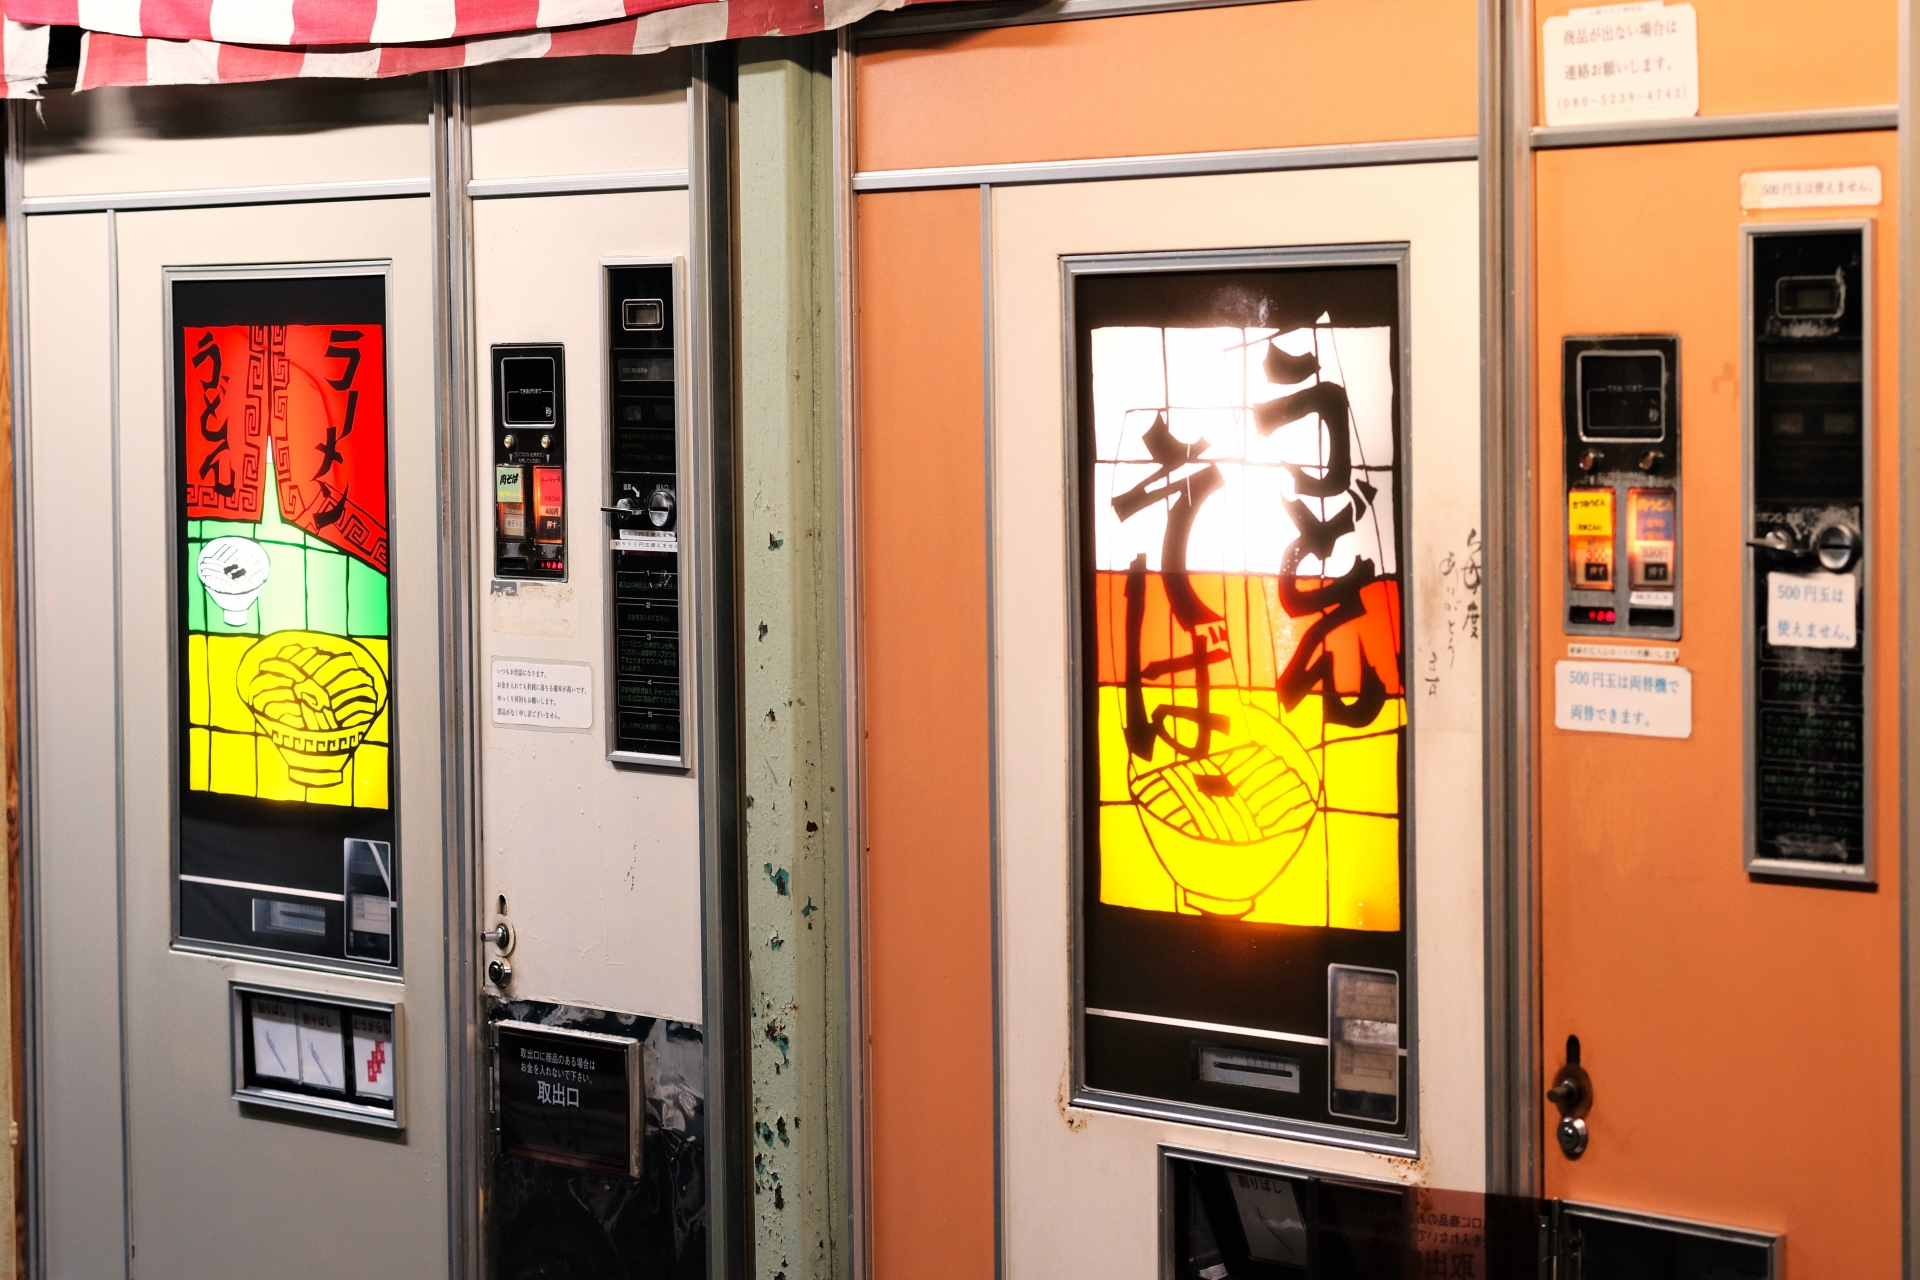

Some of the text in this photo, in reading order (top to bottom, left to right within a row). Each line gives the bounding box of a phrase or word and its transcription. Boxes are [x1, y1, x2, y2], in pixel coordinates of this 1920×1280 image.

[1563, 20, 1678, 46] 商品が出ない場合は
[1564, 57, 1673, 80] 連絡お願いします。
[191, 330, 236, 498] うどん
[312, 329, 366, 531] ラーメン
[1252, 337, 1392, 728] うどん
[1111, 410, 1232, 762] そば
[1570, 705, 1650, 728] 両替できます。
[302, 1012, 333, 1028] 割りばし
[353, 1019, 393, 1035] とうがらし
[520, 1047, 596, 1071] 取出口に商品のある場合は
[520, 1061, 593, 1085] お金を入れないで下さい。
[537, 1080, 579, 1108] 取出口
[1236, 1174, 1282, 1194] 割りばし
